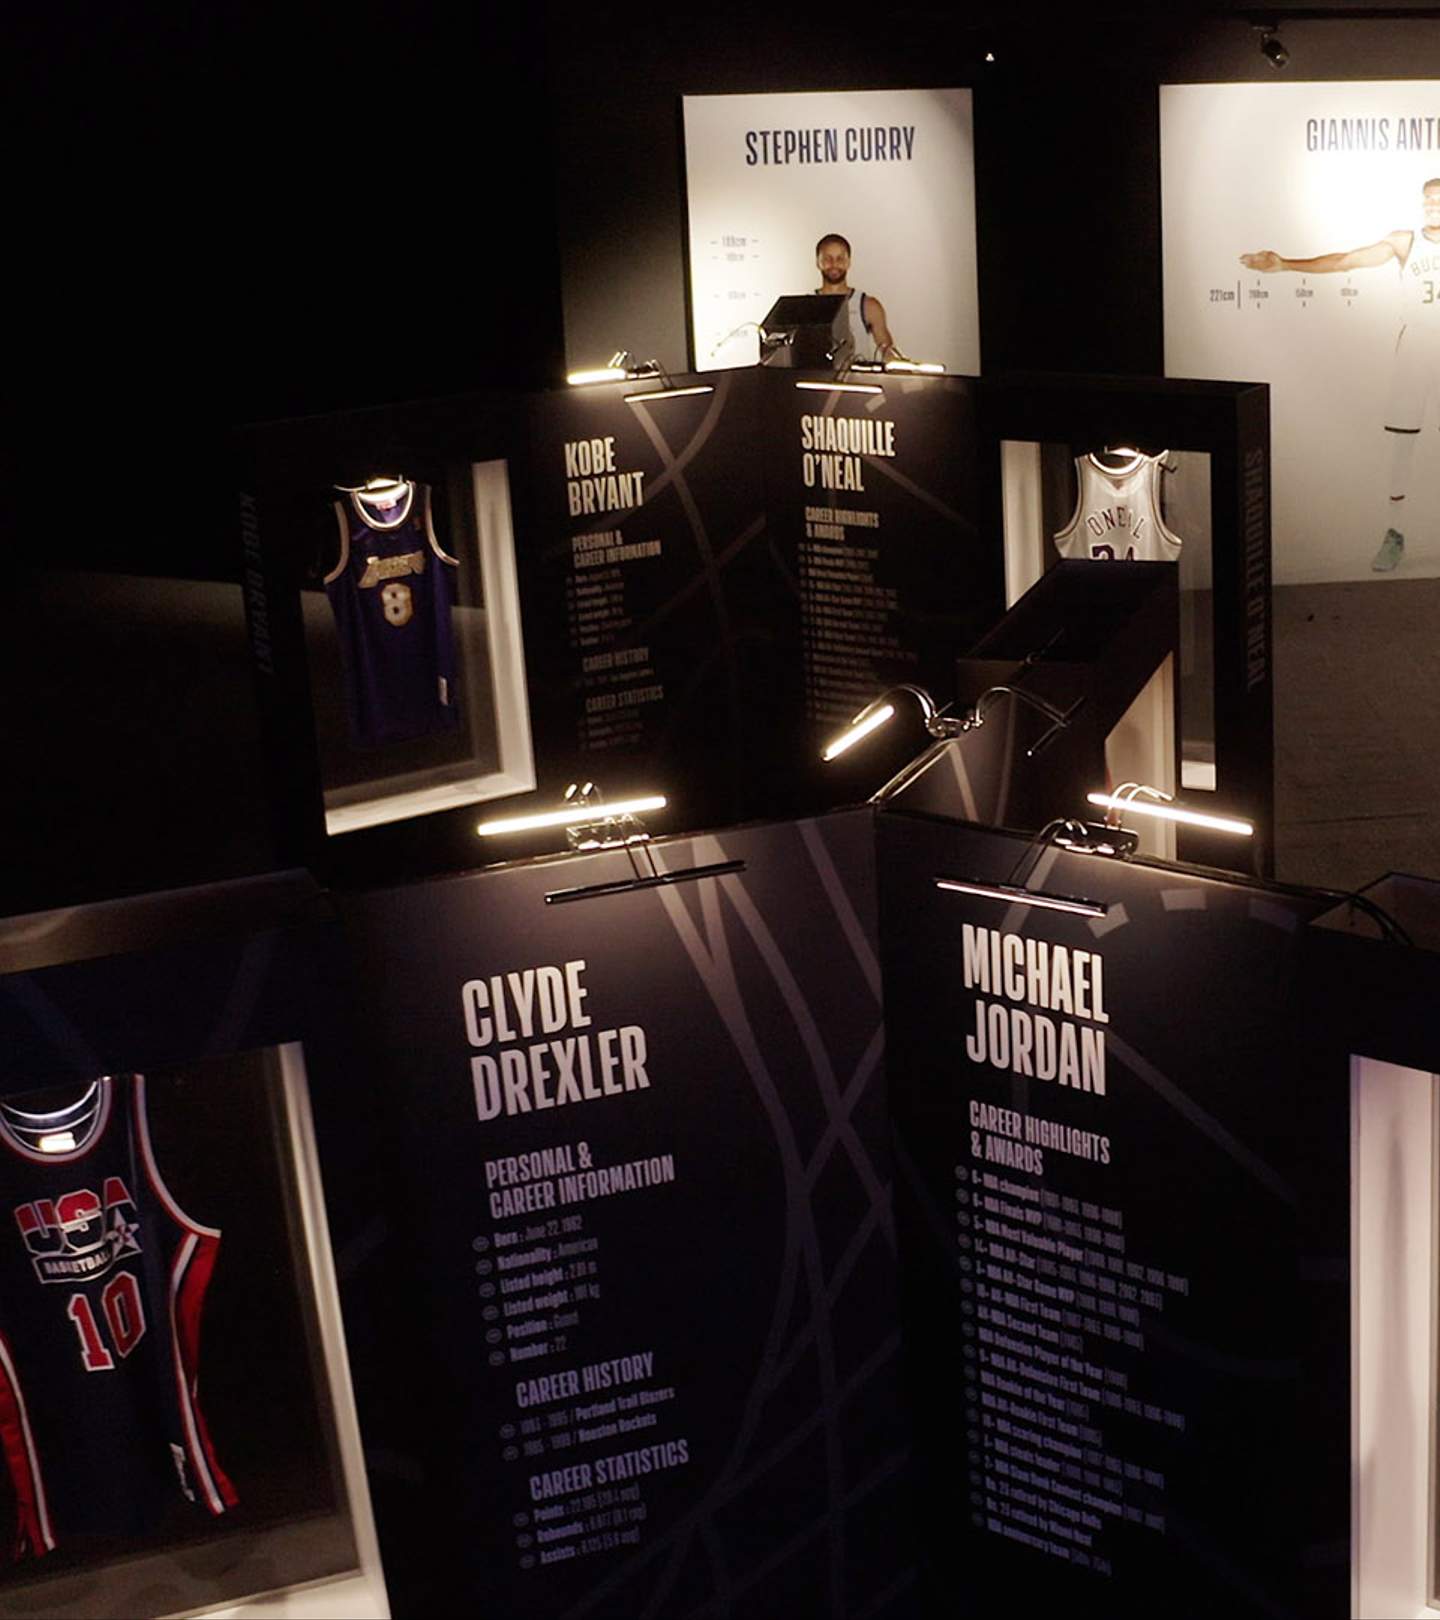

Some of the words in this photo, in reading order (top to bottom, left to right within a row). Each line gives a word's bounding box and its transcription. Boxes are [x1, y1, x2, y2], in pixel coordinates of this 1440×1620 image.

[746, 128, 838, 166] STEPHEN
[845, 126, 915, 163] CURRY
[1306, 117, 1390, 151] GIANNIS
[564, 436, 617, 478] KOBE
[800, 414, 896, 456] SHAQUILLE
[567, 470, 645, 517] BRYANT
[802, 452, 865, 492] O'NEAL
[380, 582, 415, 627] 8
[961, 922, 1110, 1024] MICHAEL
[461, 959, 592, 1048] CLYDE
[470, 1024, 651, 1122] DREXLER
[966, 998, 1107, 1097] JORDAN
[969, 1099, 1023, 1139] CAREER
[1025, 1113, 1111, 1165] HIGHLIGHTS
[970, 1130, 983, 1159] &
[984, 1134, 1044, 1176] AWARDS
[484, 1143, 576, 1189] PERSONAL
[576, 1140, 593, 1169] &
[489, 1181, 557, 1220] CAREER
[558, 1153, 676, 1206] INFORMATION
[14, 1177, 139, 1254] USA
[67, 1271, 146, 1372] 10
[515, 1370, 580, 1409] CAREER
[582, 1351, 656, 1393] HISTORY
[529, 1464, 593, 1501] CAREER
[594, 1438, 689, 1485] STATISTICS
